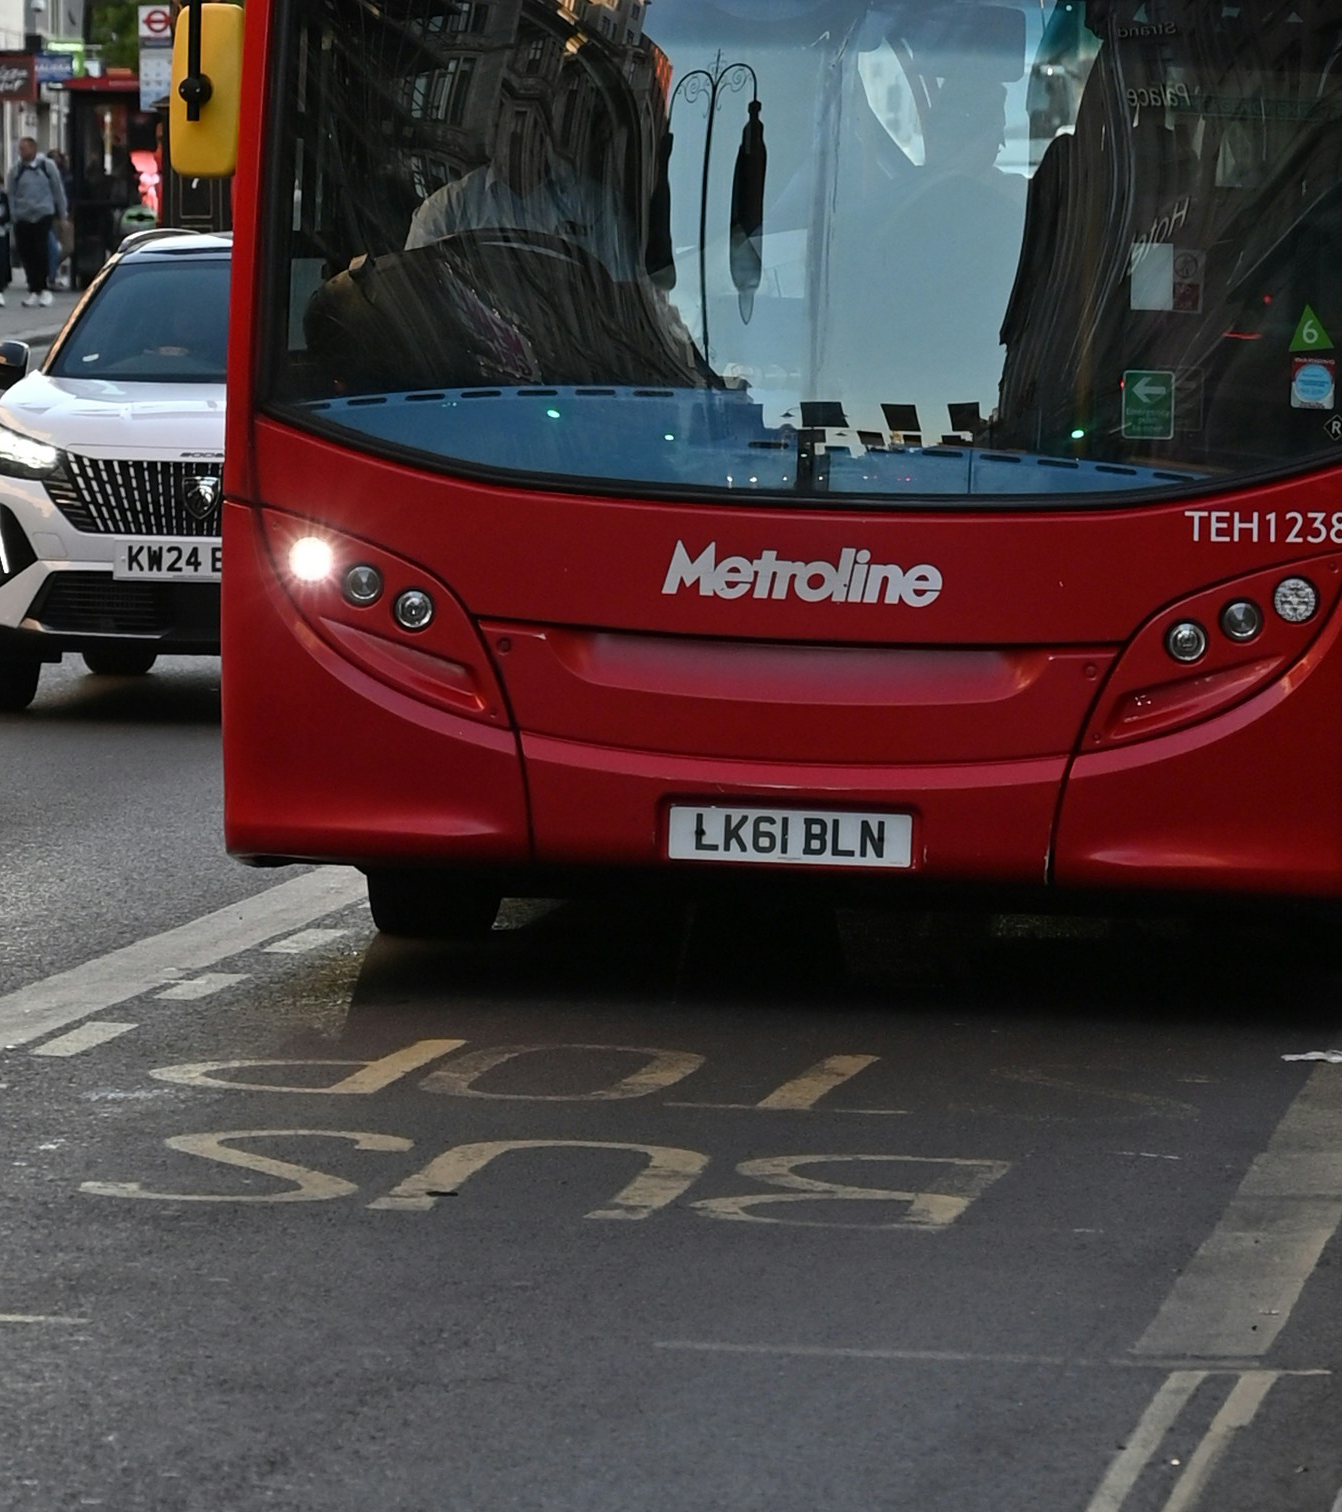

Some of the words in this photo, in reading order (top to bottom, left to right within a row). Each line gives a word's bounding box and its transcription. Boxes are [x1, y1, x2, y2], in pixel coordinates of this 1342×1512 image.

[1302, 320, 1318, 344] 6
[1332, 421, 1341, 435] R
[128, 545, 201, 572] KW24
[662, 540, 942, 607] Metroline
[693, 813, 790, 853] LK61
[801, 818, 885, 858] BLN
[79, 1129, 1011, 1229] BUS
